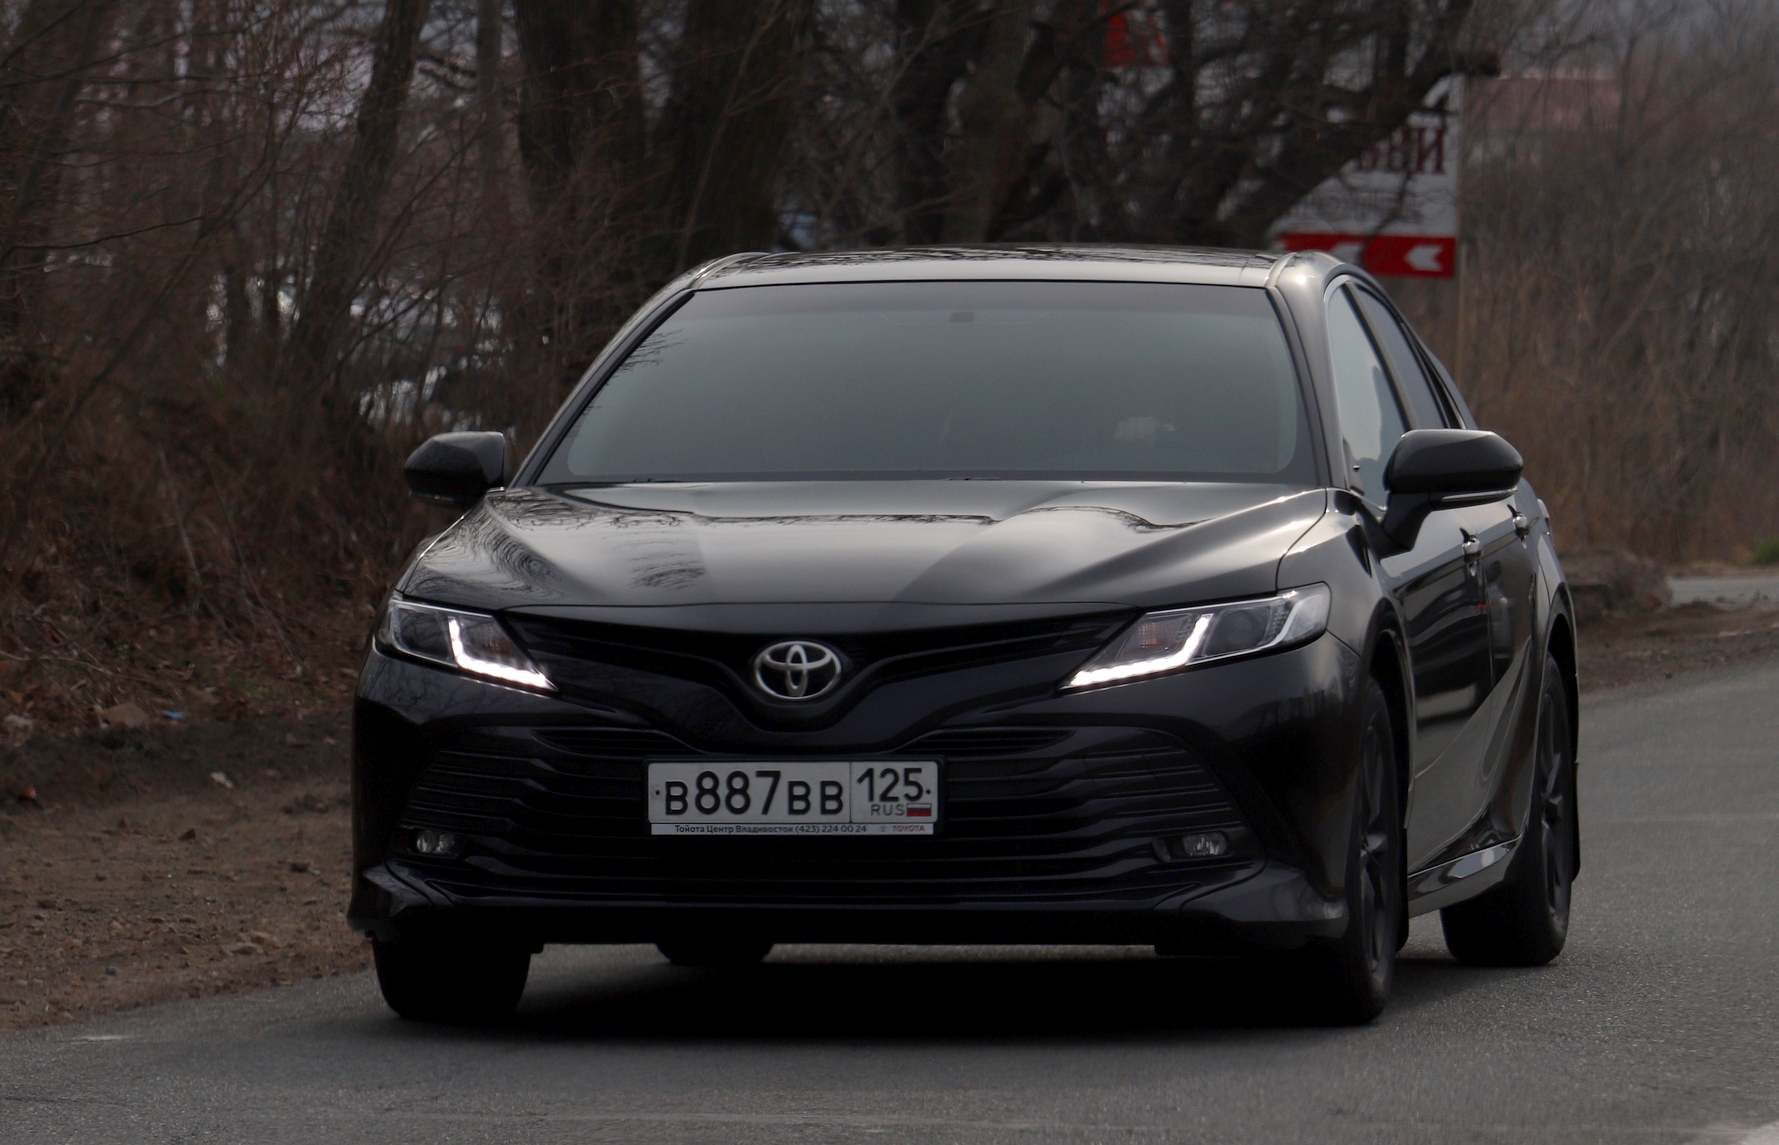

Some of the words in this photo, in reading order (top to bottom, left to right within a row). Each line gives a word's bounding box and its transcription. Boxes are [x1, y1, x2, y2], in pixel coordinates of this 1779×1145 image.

[857, 767, 924, 802] 125
[871, 804, 905, 816] RUS
[675, 824, 705, 833] Тойота
[706, 825, 734, 834] Центр
[736, 825, 793, 834] Владивосток
[795, 825, 819, 834] (423)
[821, 825, 838, 833] 224
[840, 825, 854, 833] 00
[855, 825, 867, 833] 24
